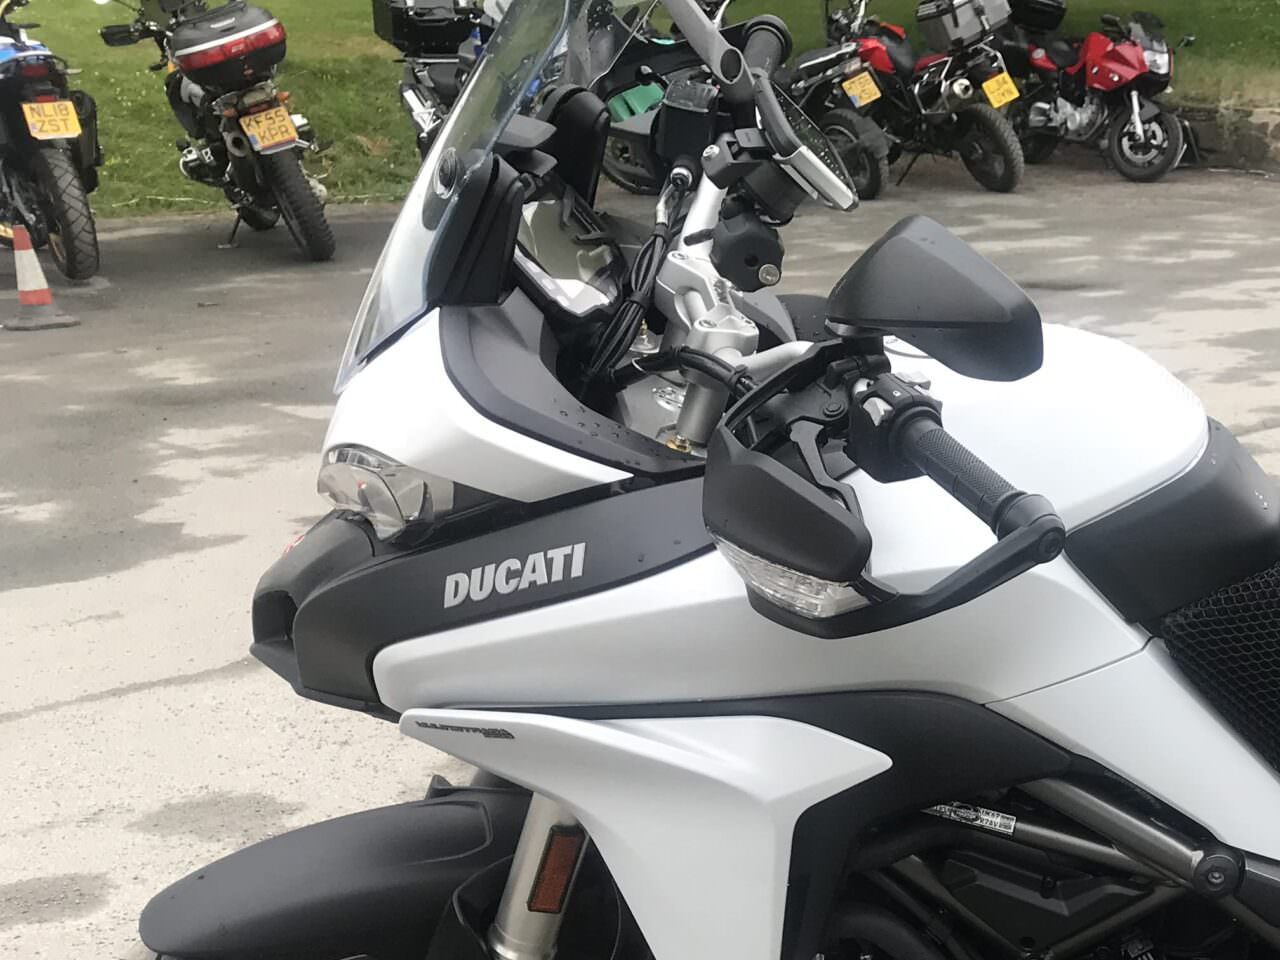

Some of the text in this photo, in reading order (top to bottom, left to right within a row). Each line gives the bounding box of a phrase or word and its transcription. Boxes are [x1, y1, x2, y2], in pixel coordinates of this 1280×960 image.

[29, 103, 70, 119] NL18
[243, 109, 286, 131] KF55
[37, 119, 70, 133] ZST
[258, 124, 291, 144] KPR
[443, 542, 587, 609] DUCATI
